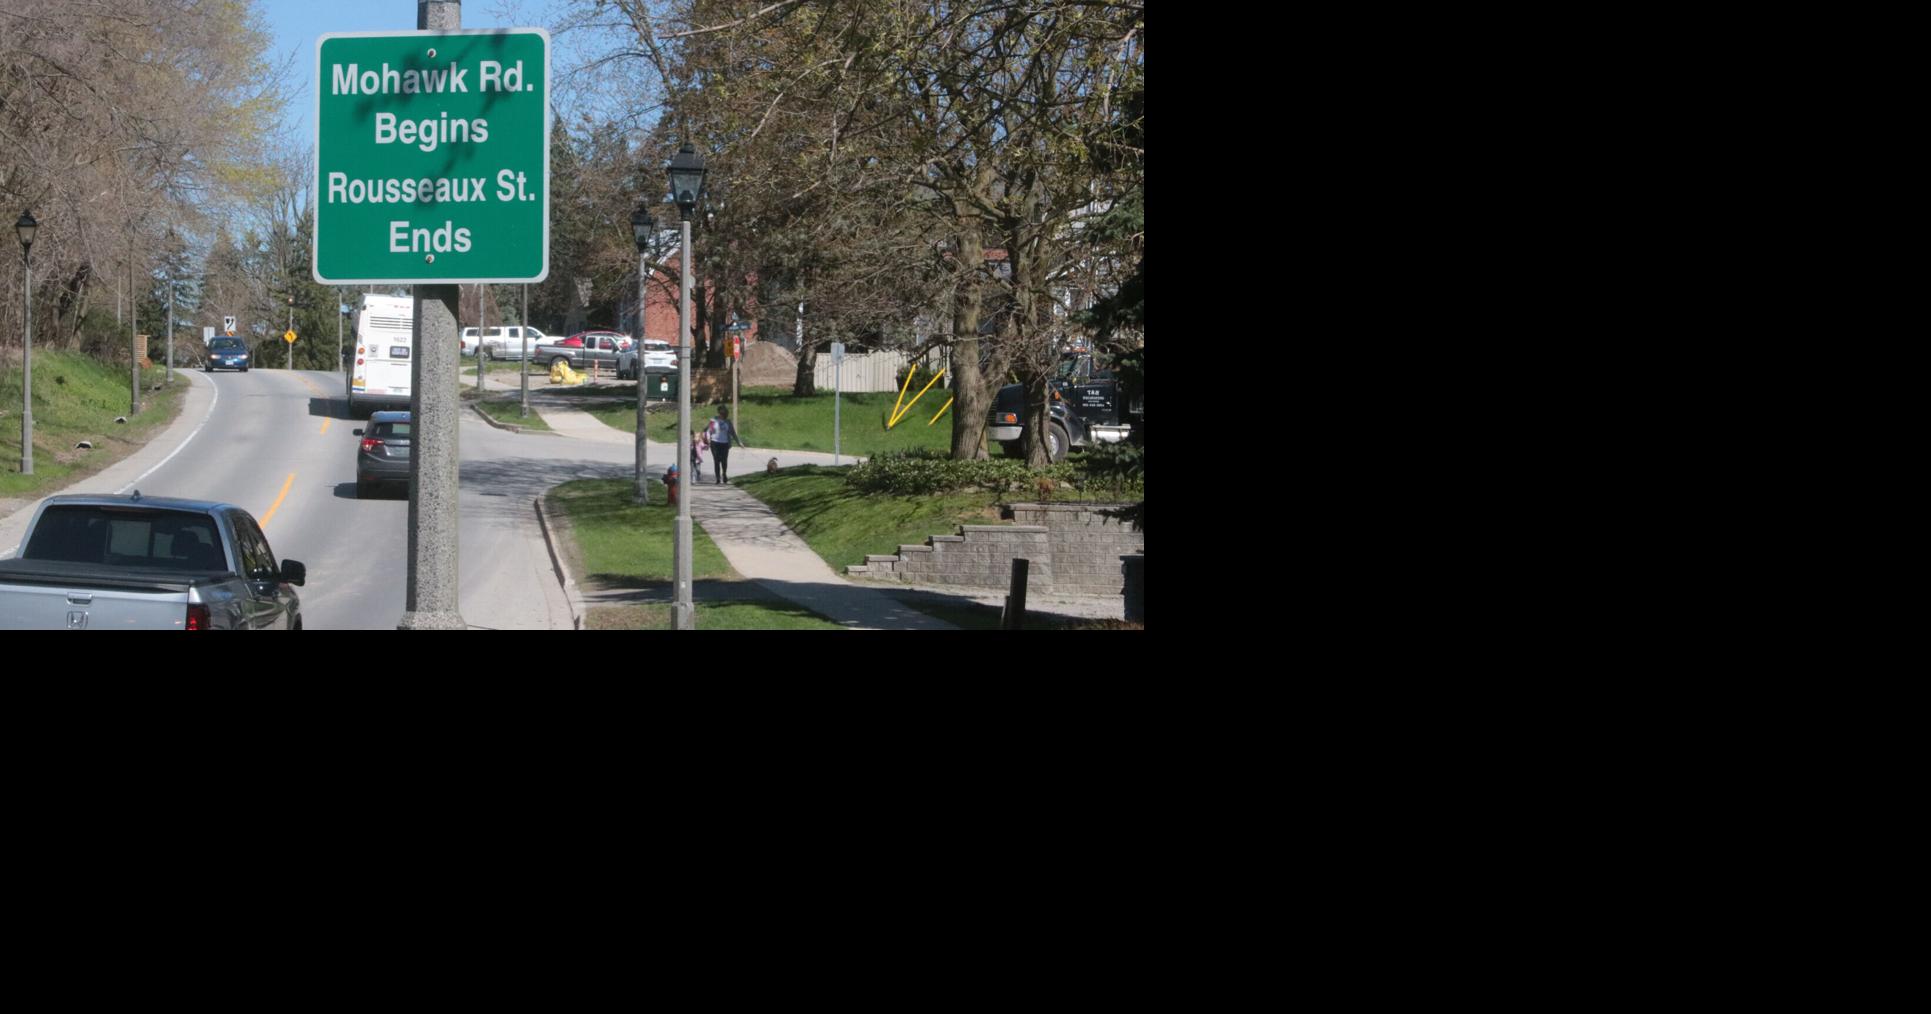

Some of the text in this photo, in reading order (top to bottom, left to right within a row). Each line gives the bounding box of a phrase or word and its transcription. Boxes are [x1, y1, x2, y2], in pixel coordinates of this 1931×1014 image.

[332, 60, 534, 95] Mohawk Rd.
[375, 112, 489, 152] Begins
[328, 169, 536, 203] Rousseaux St.
[389, 221, 472, 253] Ends
